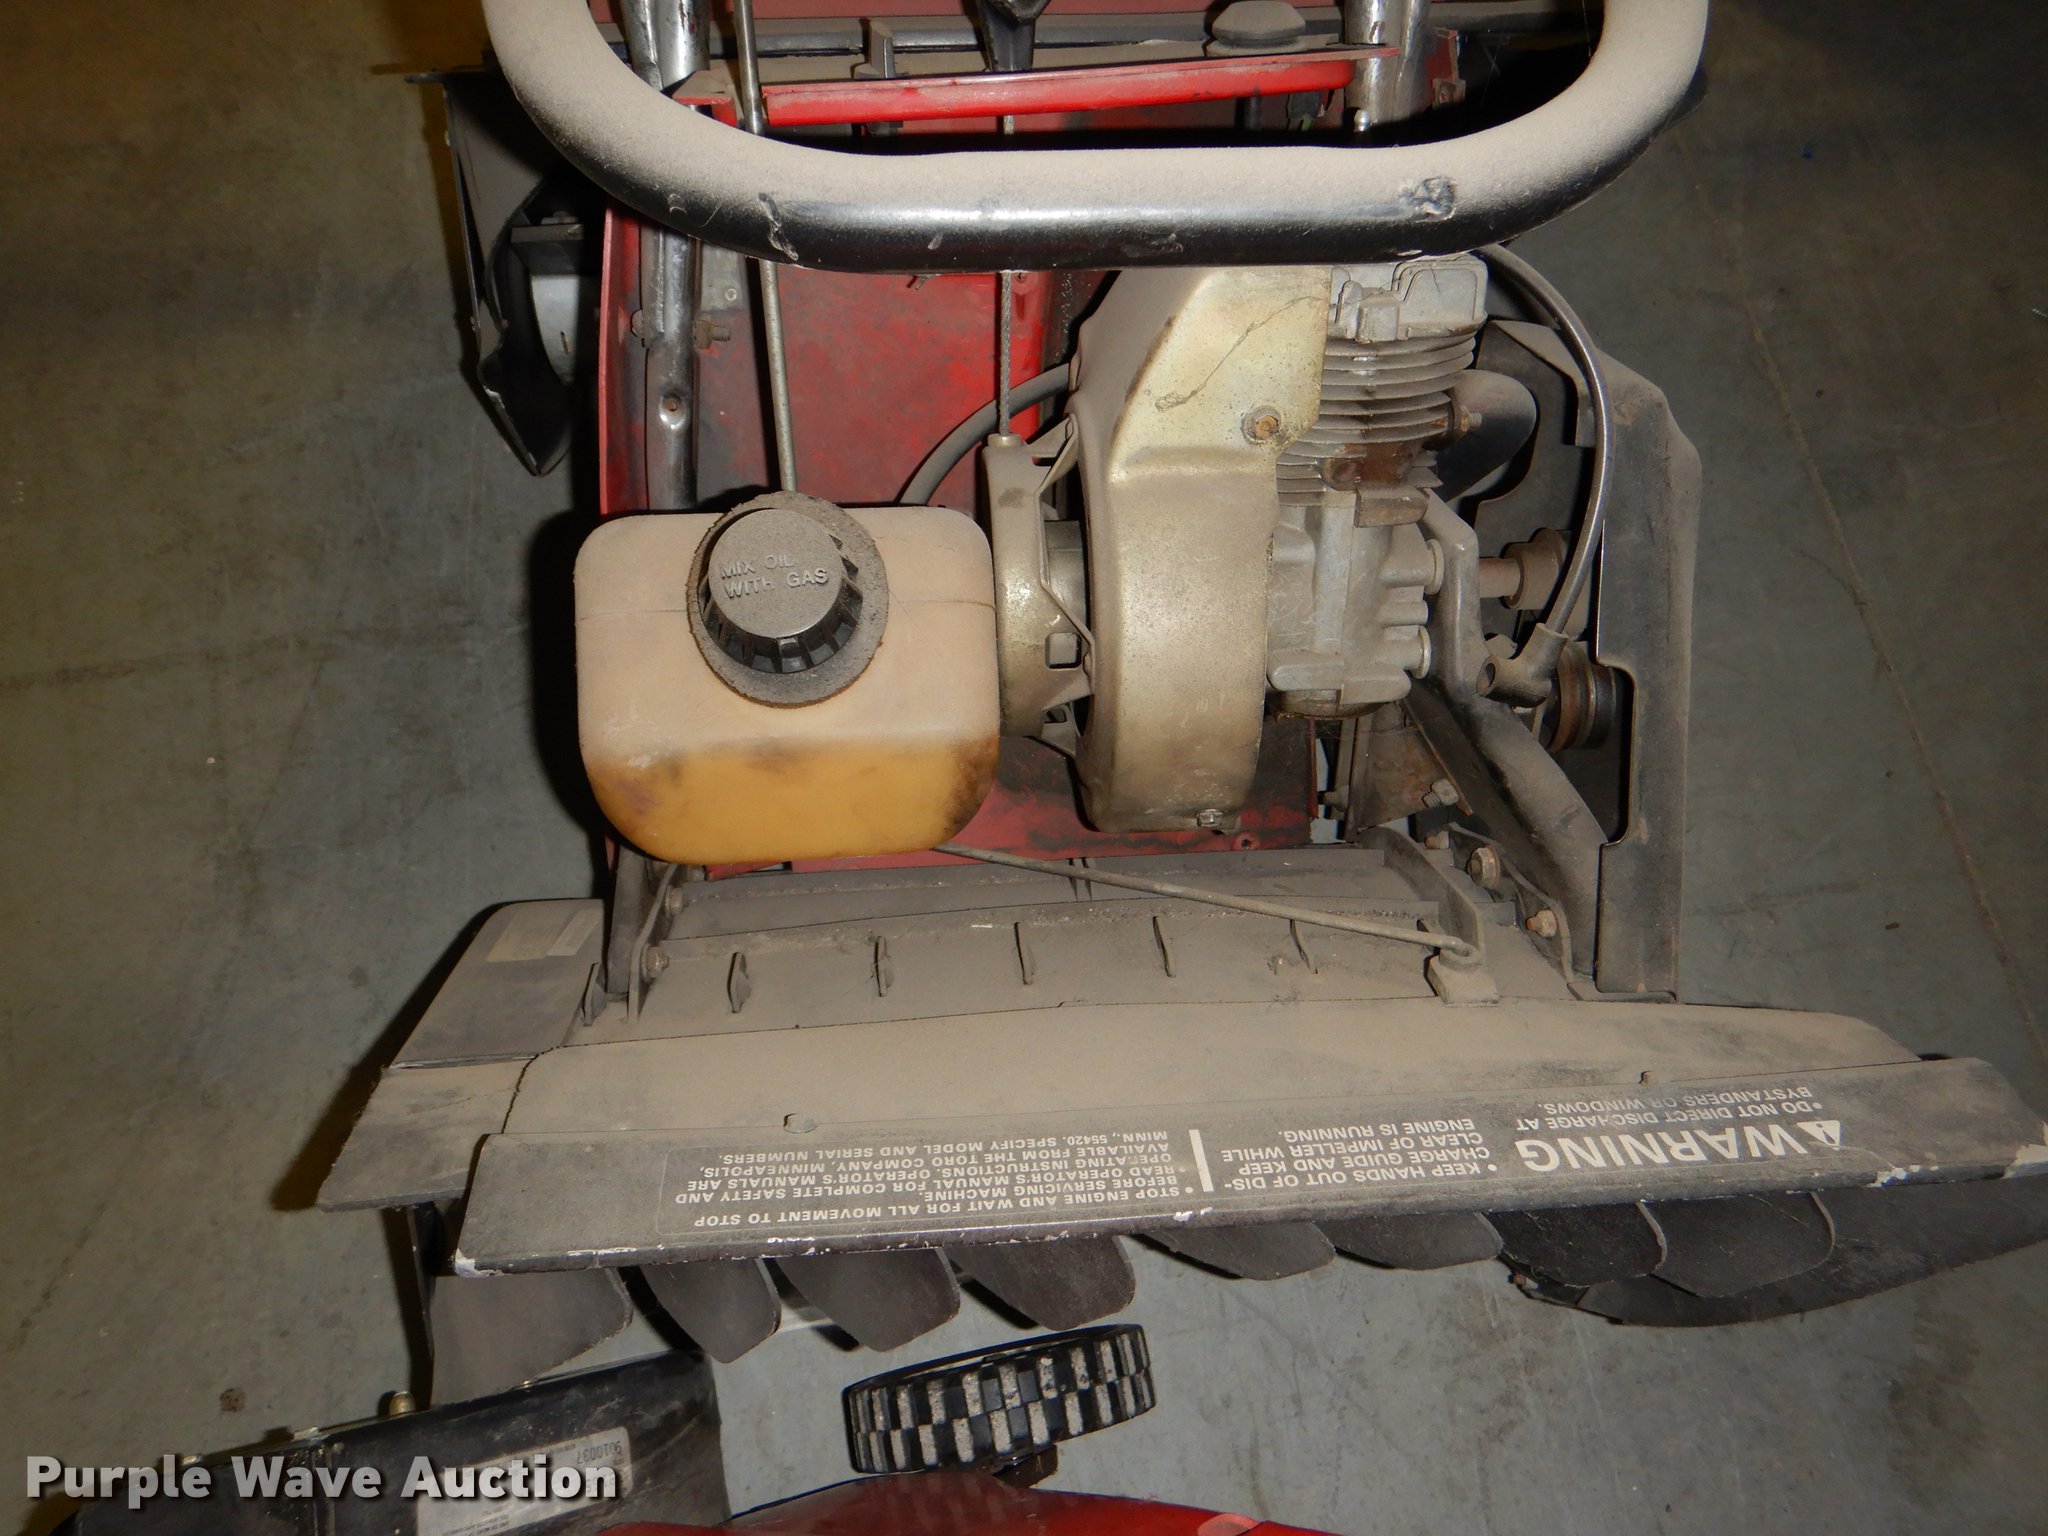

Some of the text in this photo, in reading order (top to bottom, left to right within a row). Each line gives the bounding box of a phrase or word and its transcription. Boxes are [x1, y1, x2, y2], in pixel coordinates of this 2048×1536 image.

[721, 554, 794, 578] MIX OIL
[724, 568, 828, 598] WITH GAS
[1537, 1087, 1813, 1115] BYSTANDERS OR WINDOWS.
[1280, 1119, 1475, 1142] ENGINE IS RUNNING.
[1517, 1102, 1812, 1131] DO NOT DIRECT DISCHARGE AT
[700, 1143, 1168, 1177] AVAILABLE FROM THE TORO COMPANY, MINNEAPOLIS,
[719, 1131, 1167, 1164] MINN., 55420. SPECIFY MODEL AND SERIAL NUMBERS.
[1221, 1132, 1483, 1162] CLEAR OF IMPELLER WHILE
[1515, 1123, 1808, 1172] WARNING
[938, 1161, 1068, 1176] INSTRUCTIONS.
[1239, 1147, 1490, 1176] CHARGE GUIDE AND KEEP
[675, 1166, 1174, 1203] READ OPERATOR'S MANUAL FOR COMPLETE SAFETY AND
[688, 1181, 719, 1190] ARE
[728, 1176, 815, 1189] MANUALS
[823, 1170, 930, 1184] OPERATOR'S
[919, 1176, 1177, 1202] BEFORE SERVICING MACHINE.
[1225, 1162, 1481, 1190] KEEP HANDS OUT OF DIS-
[695, 1186, 1179, 1227] STOP ENGINE AND WAIT FOR ALL MOVEMENT TO STOP
